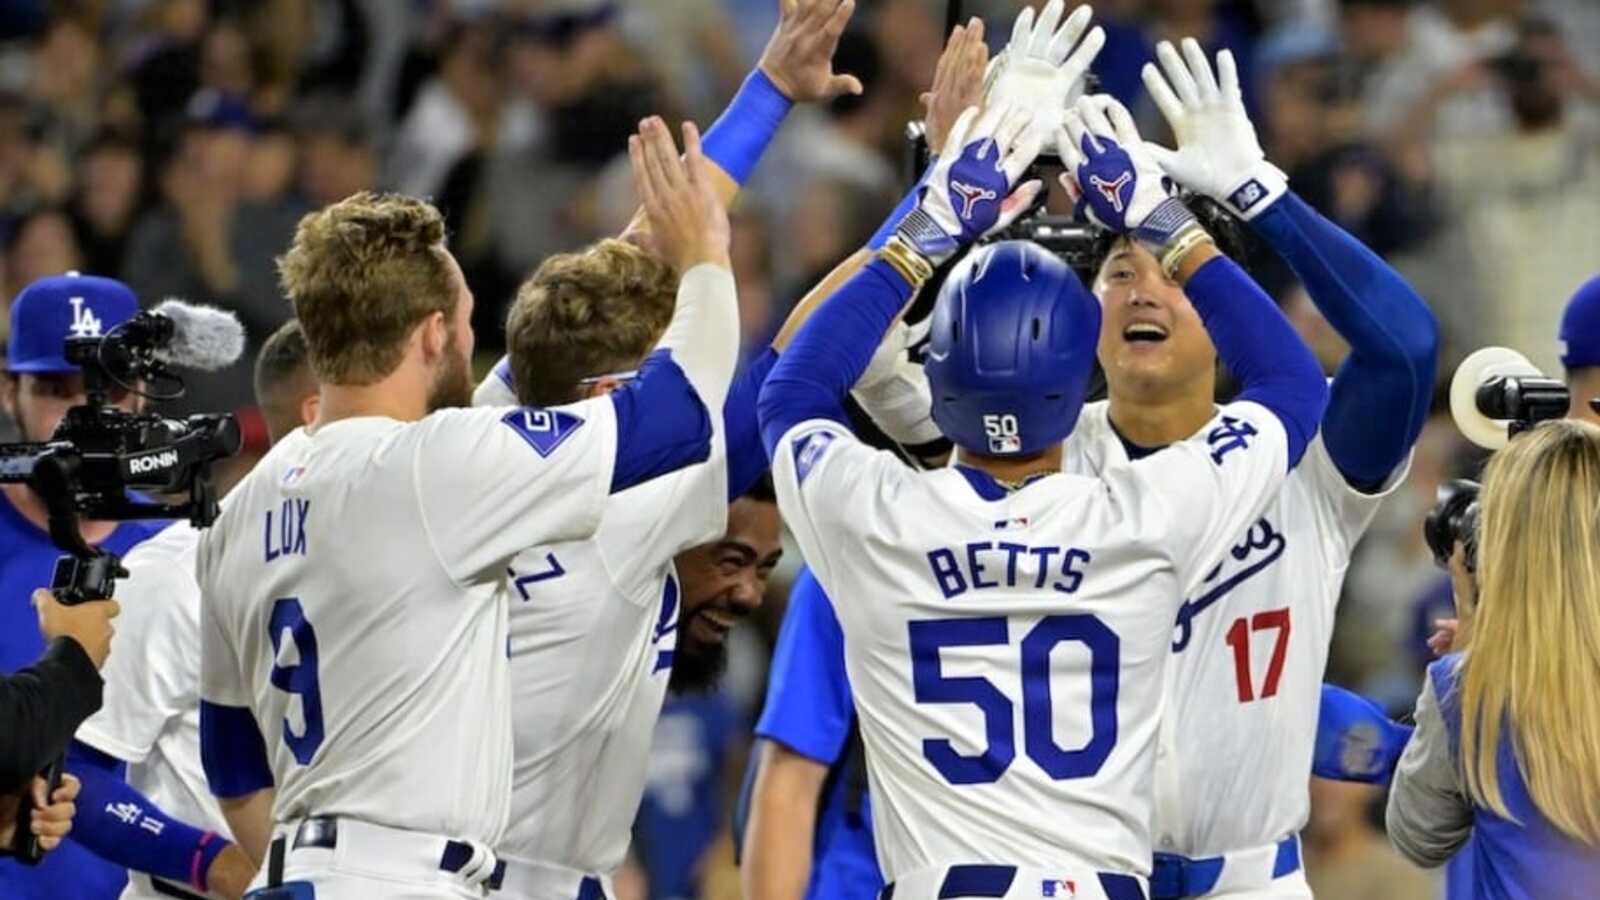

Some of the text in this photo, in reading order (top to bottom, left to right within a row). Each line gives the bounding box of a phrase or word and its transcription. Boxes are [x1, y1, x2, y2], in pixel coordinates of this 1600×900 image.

[69, 296, 102, 337] LA
[983, 414, 1018, 437] 50
[129, 450, 178, 475] RONIN
[265, 498, 310, 562] LUX
[928, 541, 1090, 599] BETTS
[268, 597, 325, 766] 9
[1225, 607, 1291, 703] 17
[908, 613, 1121, 785] 50
